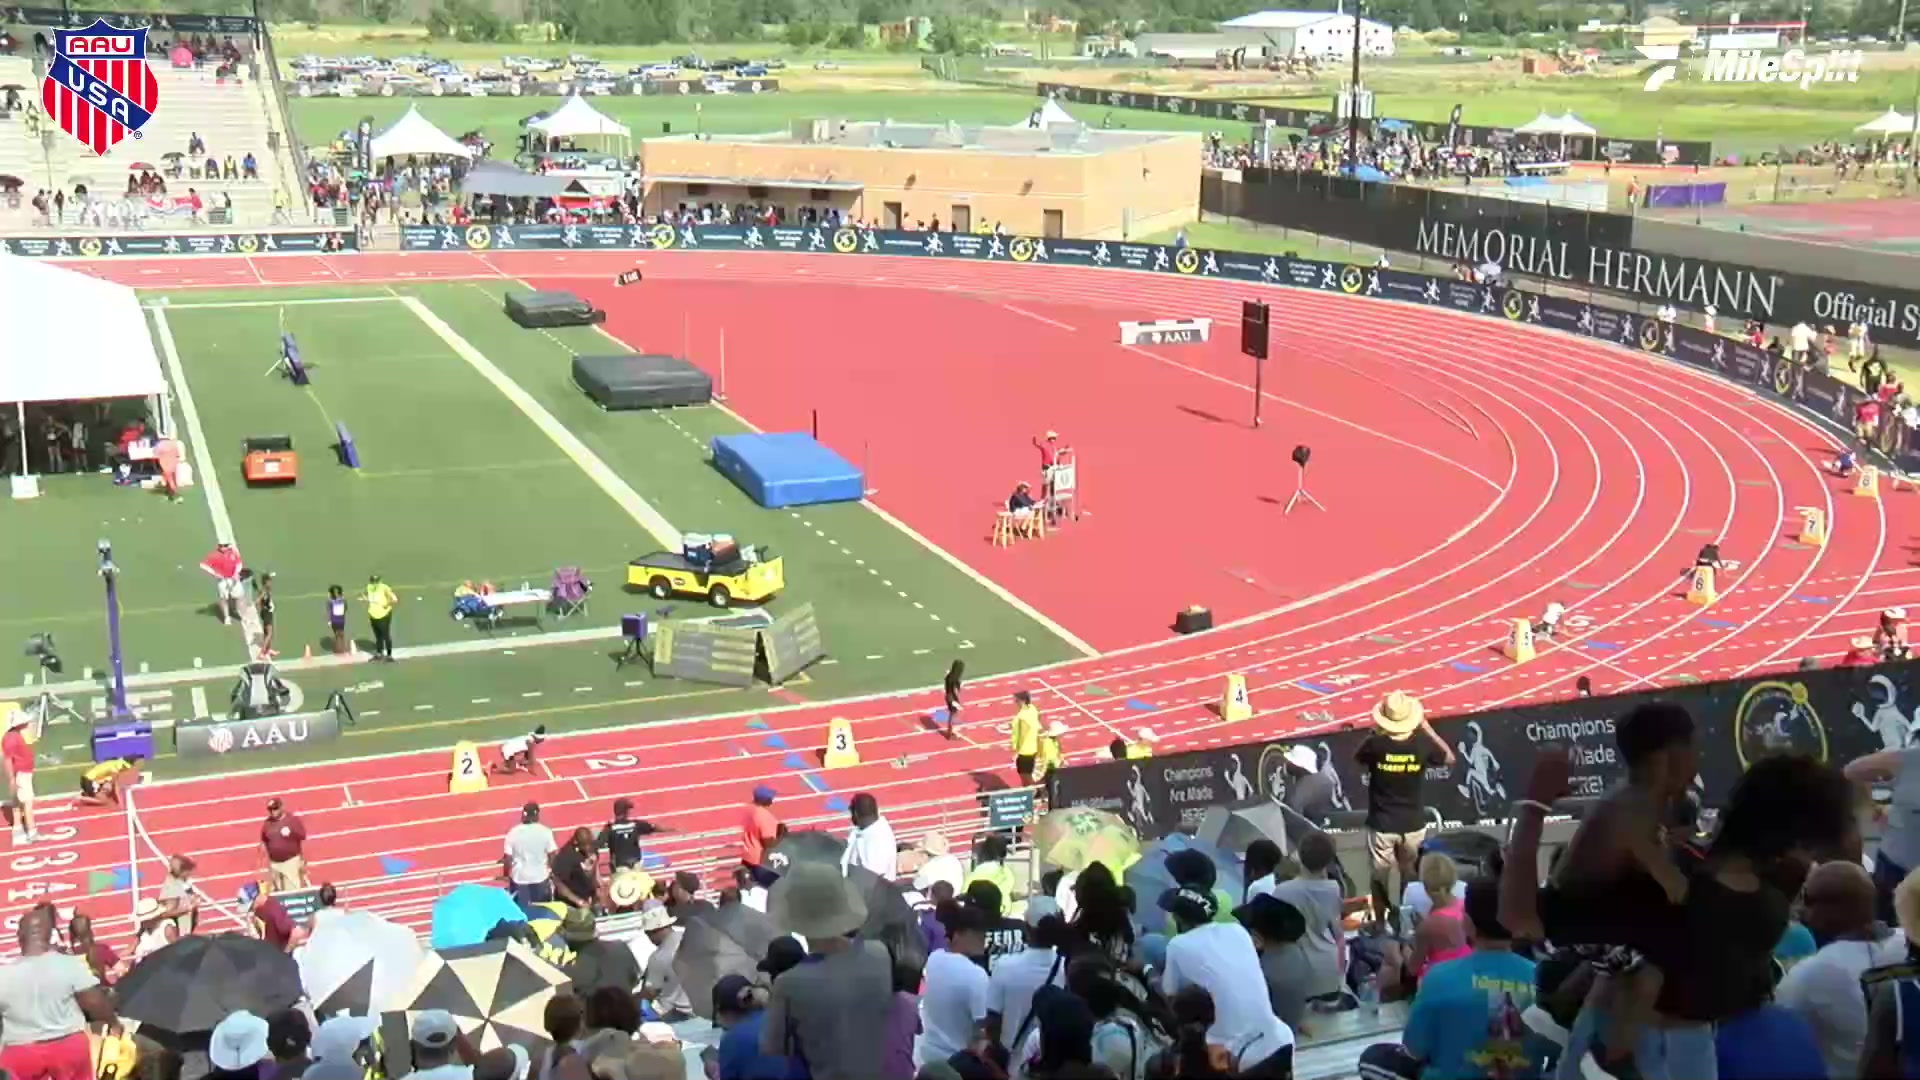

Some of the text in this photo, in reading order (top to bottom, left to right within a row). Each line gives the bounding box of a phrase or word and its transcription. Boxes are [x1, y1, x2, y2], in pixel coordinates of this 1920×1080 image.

[1415, 217, 1777, 317] MEMORIAL HERMANN
[1813, 290, 1897, 329] Official
[1695, 576, 1705, 591] 6
[241, 719, 310, 749] AAU
[1525, 716, 1617, 743] Champions
[835, 733, 847, 751] 3
[461, 757, 473, 775] 2
[584, 753, 640, 770] 2
[10, 851, 79, 871] 3
